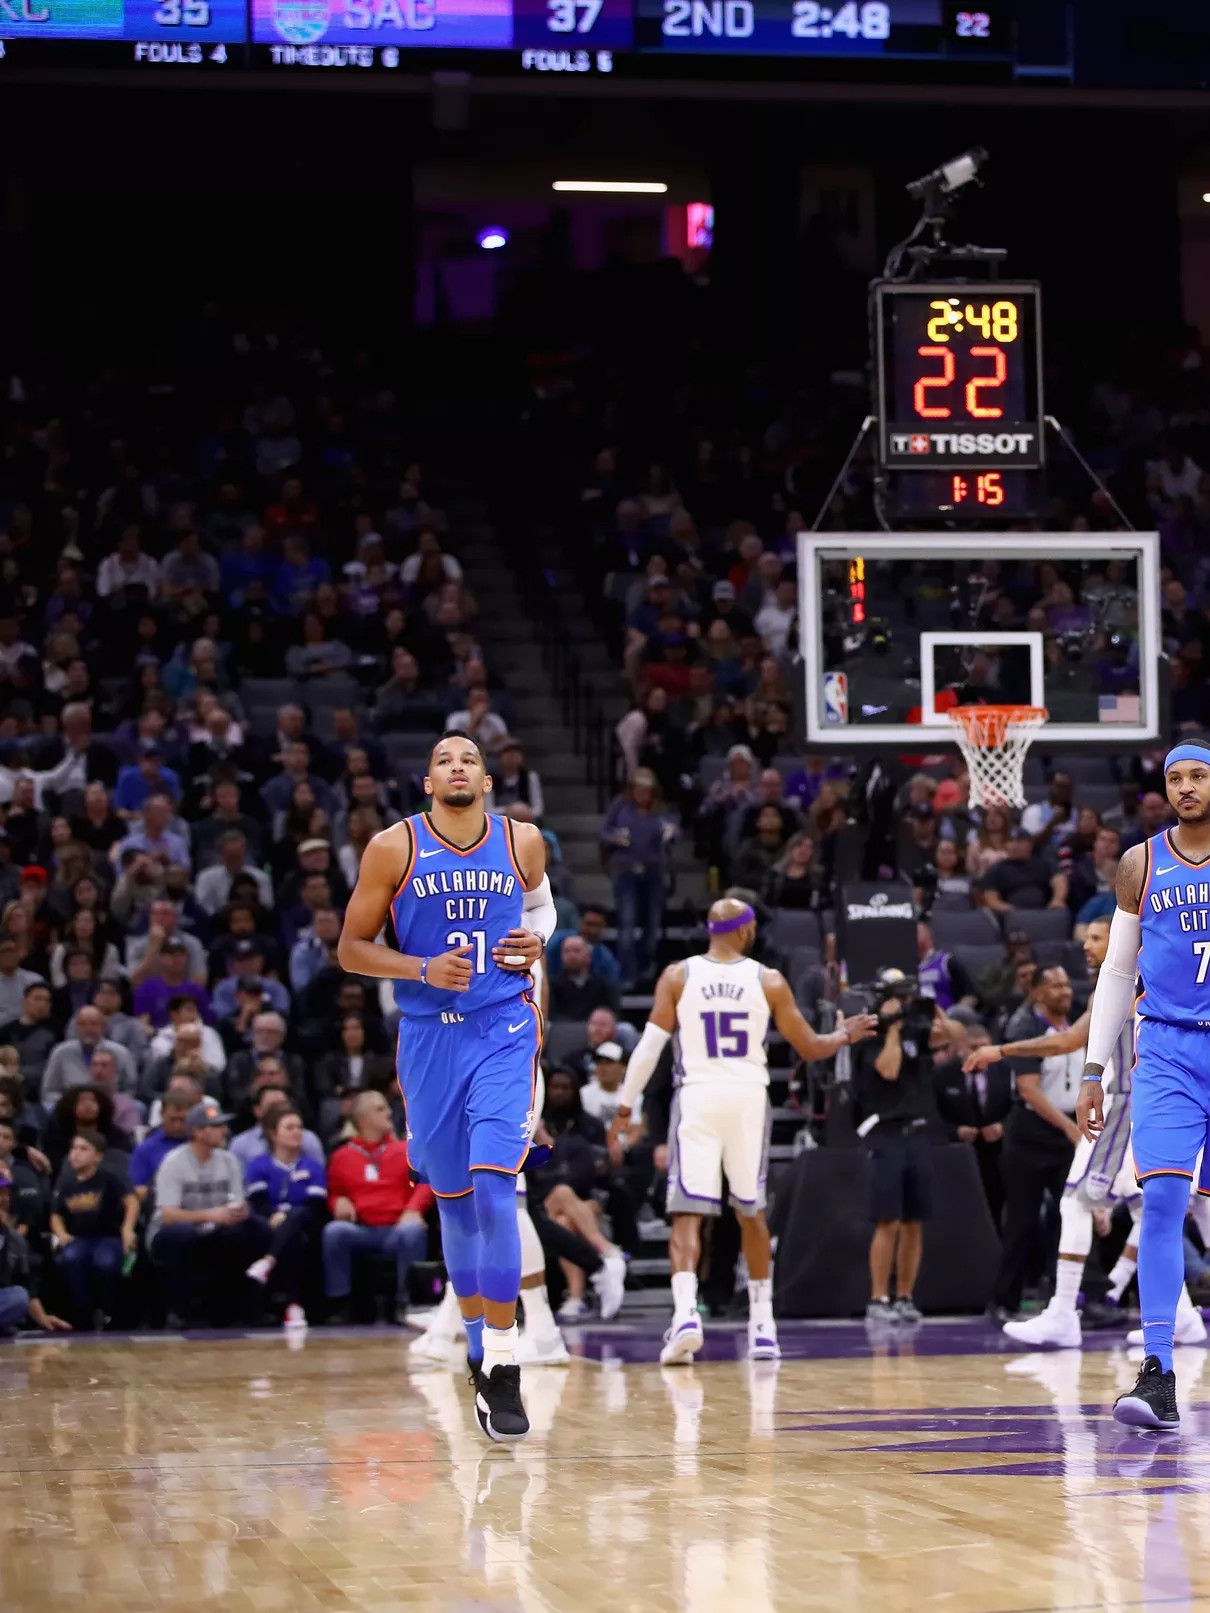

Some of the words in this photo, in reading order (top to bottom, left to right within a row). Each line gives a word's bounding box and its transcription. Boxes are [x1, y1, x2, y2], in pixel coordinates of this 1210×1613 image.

[344, 0, 435, 30] SAC
[547, 0, 602, 33] 37
[662, 0, 754, 37] 2ND
[792, 1, 890, 39] 2:48
[955, 12, 990, 37] 22
[133, 41, 203, 63] FOULS
[208, 43, 228, 63] 4
[522, 49, 591, 71] FOULS
[927, 300, 1018, 343] 2:48
[913, 346, 1007, 418] 22
[930, 433, 1034, 455] TISSOT
[953, 473, 1004, 505] 1:15
[412, 869, 516, 898] OKLAHOMA
[445, 898, 488, 920] CITY
[847, 903, 913, 920] SPALDING
[701, 983, 744, 1000] CARTER
[700, 1011, 749, 1058] 15
